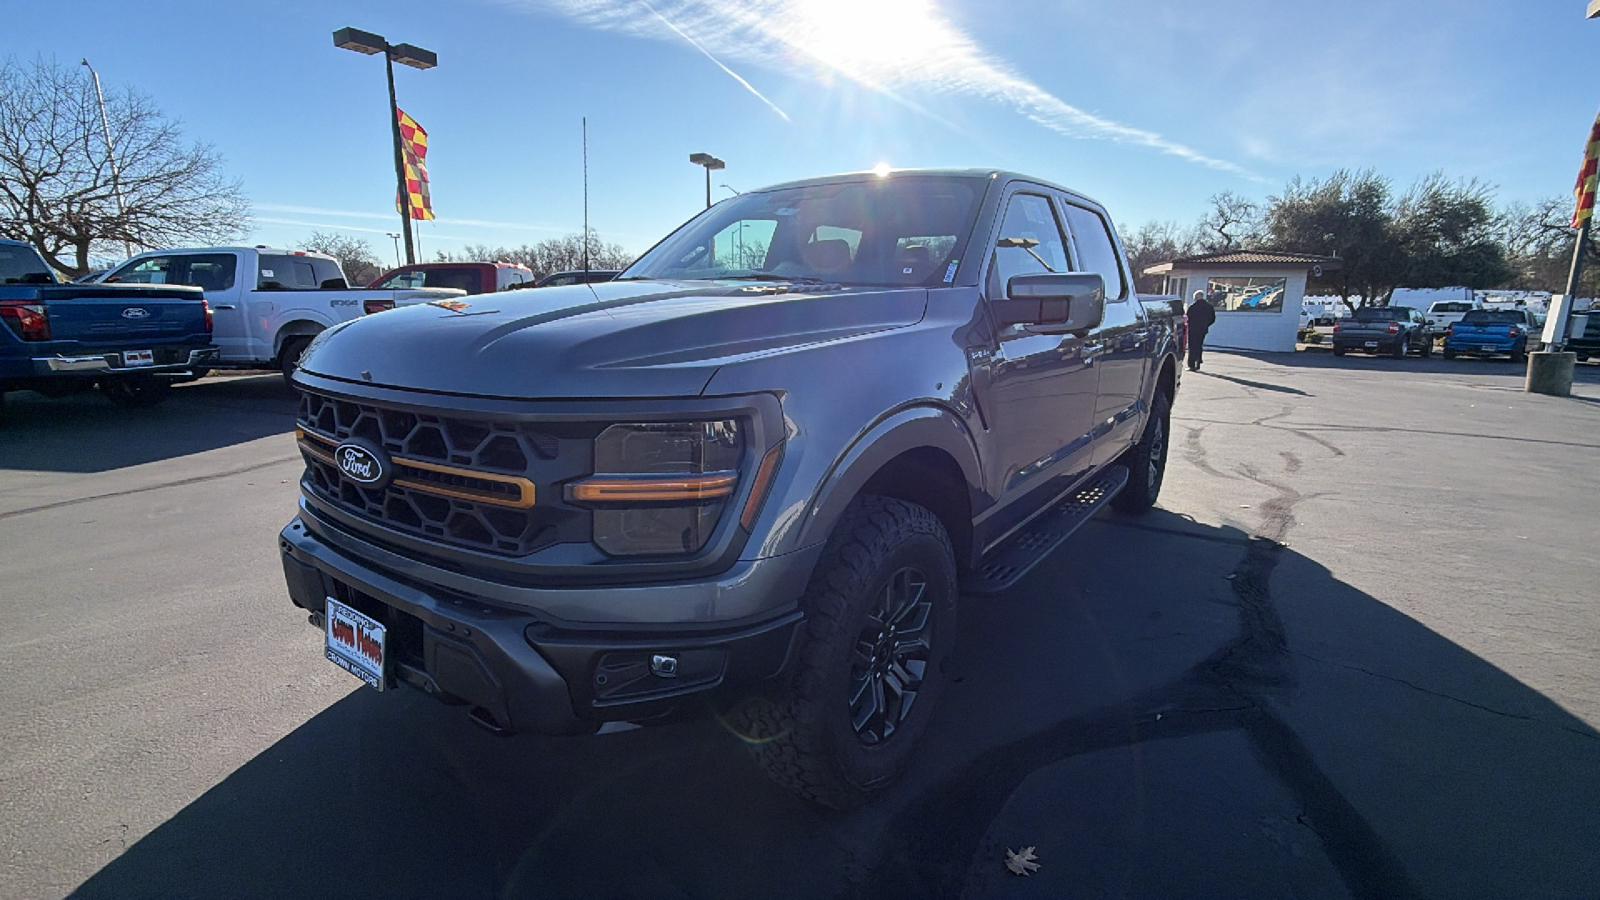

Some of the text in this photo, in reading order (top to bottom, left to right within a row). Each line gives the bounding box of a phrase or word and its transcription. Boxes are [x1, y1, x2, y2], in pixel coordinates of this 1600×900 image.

[343, 448, 371, 477] Ford
[338, 606, 369, 628] REDDING
[327, 651, 350, 671] CROWN
[350, 665, 378, 688] MOTORS
